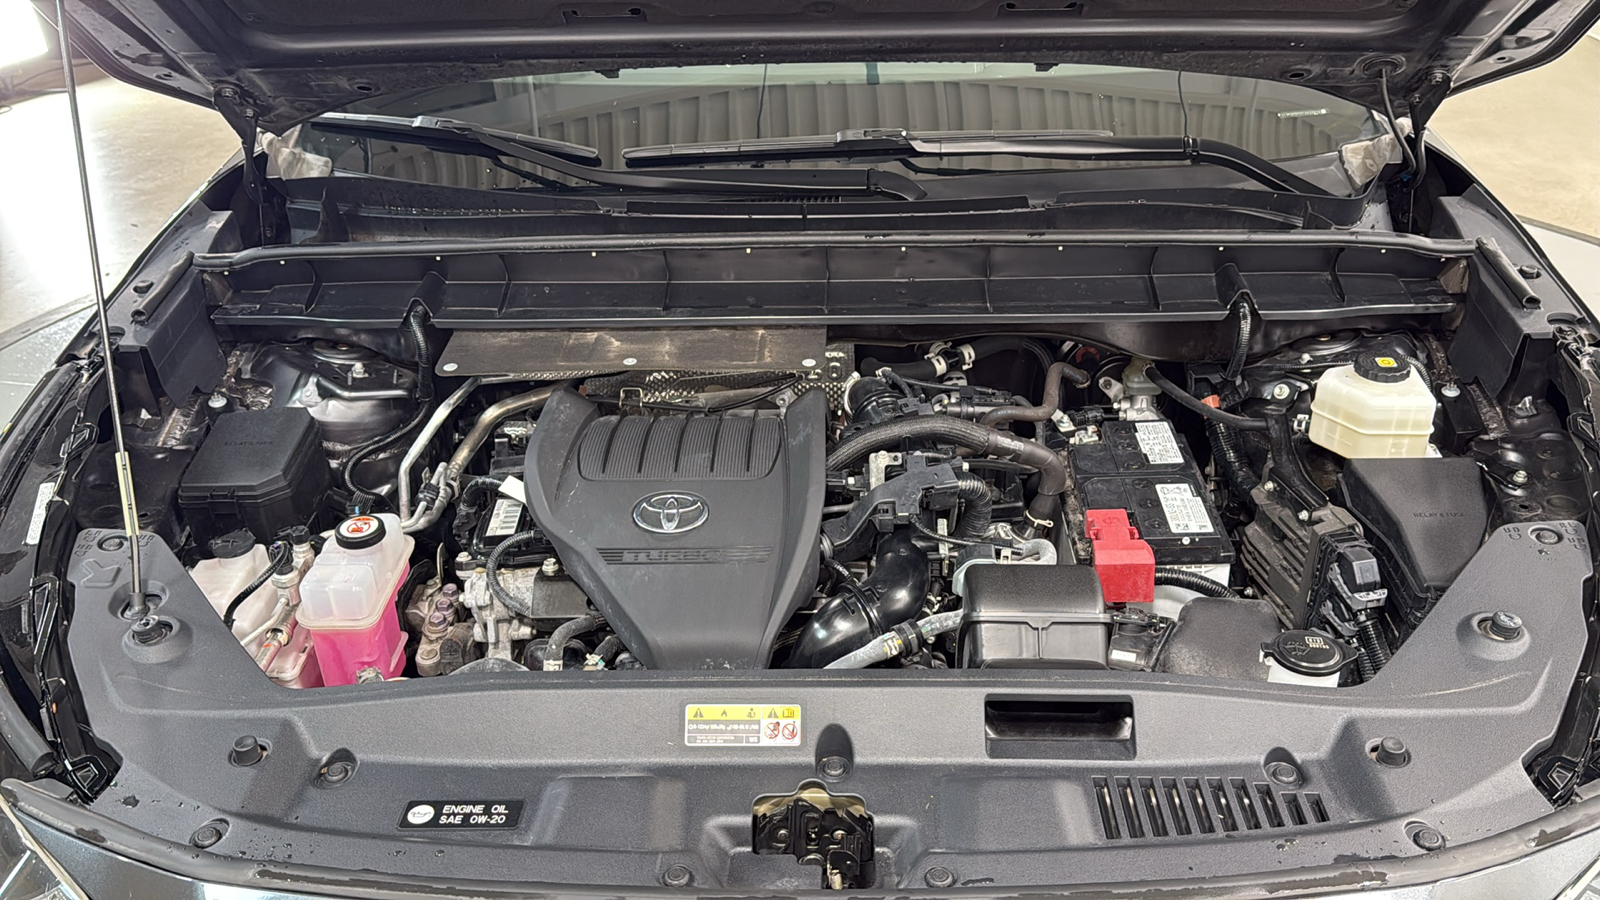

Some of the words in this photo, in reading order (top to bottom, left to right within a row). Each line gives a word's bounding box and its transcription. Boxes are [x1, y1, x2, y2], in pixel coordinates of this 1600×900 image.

[625, 550, 721, 561] TURBO
[442, 804, 486, 814] ENGINE
[491, 804, 509, 814] OIL
[438, 814, 464, 824] SAE
[469, 814, 506, 824] 0W-20
